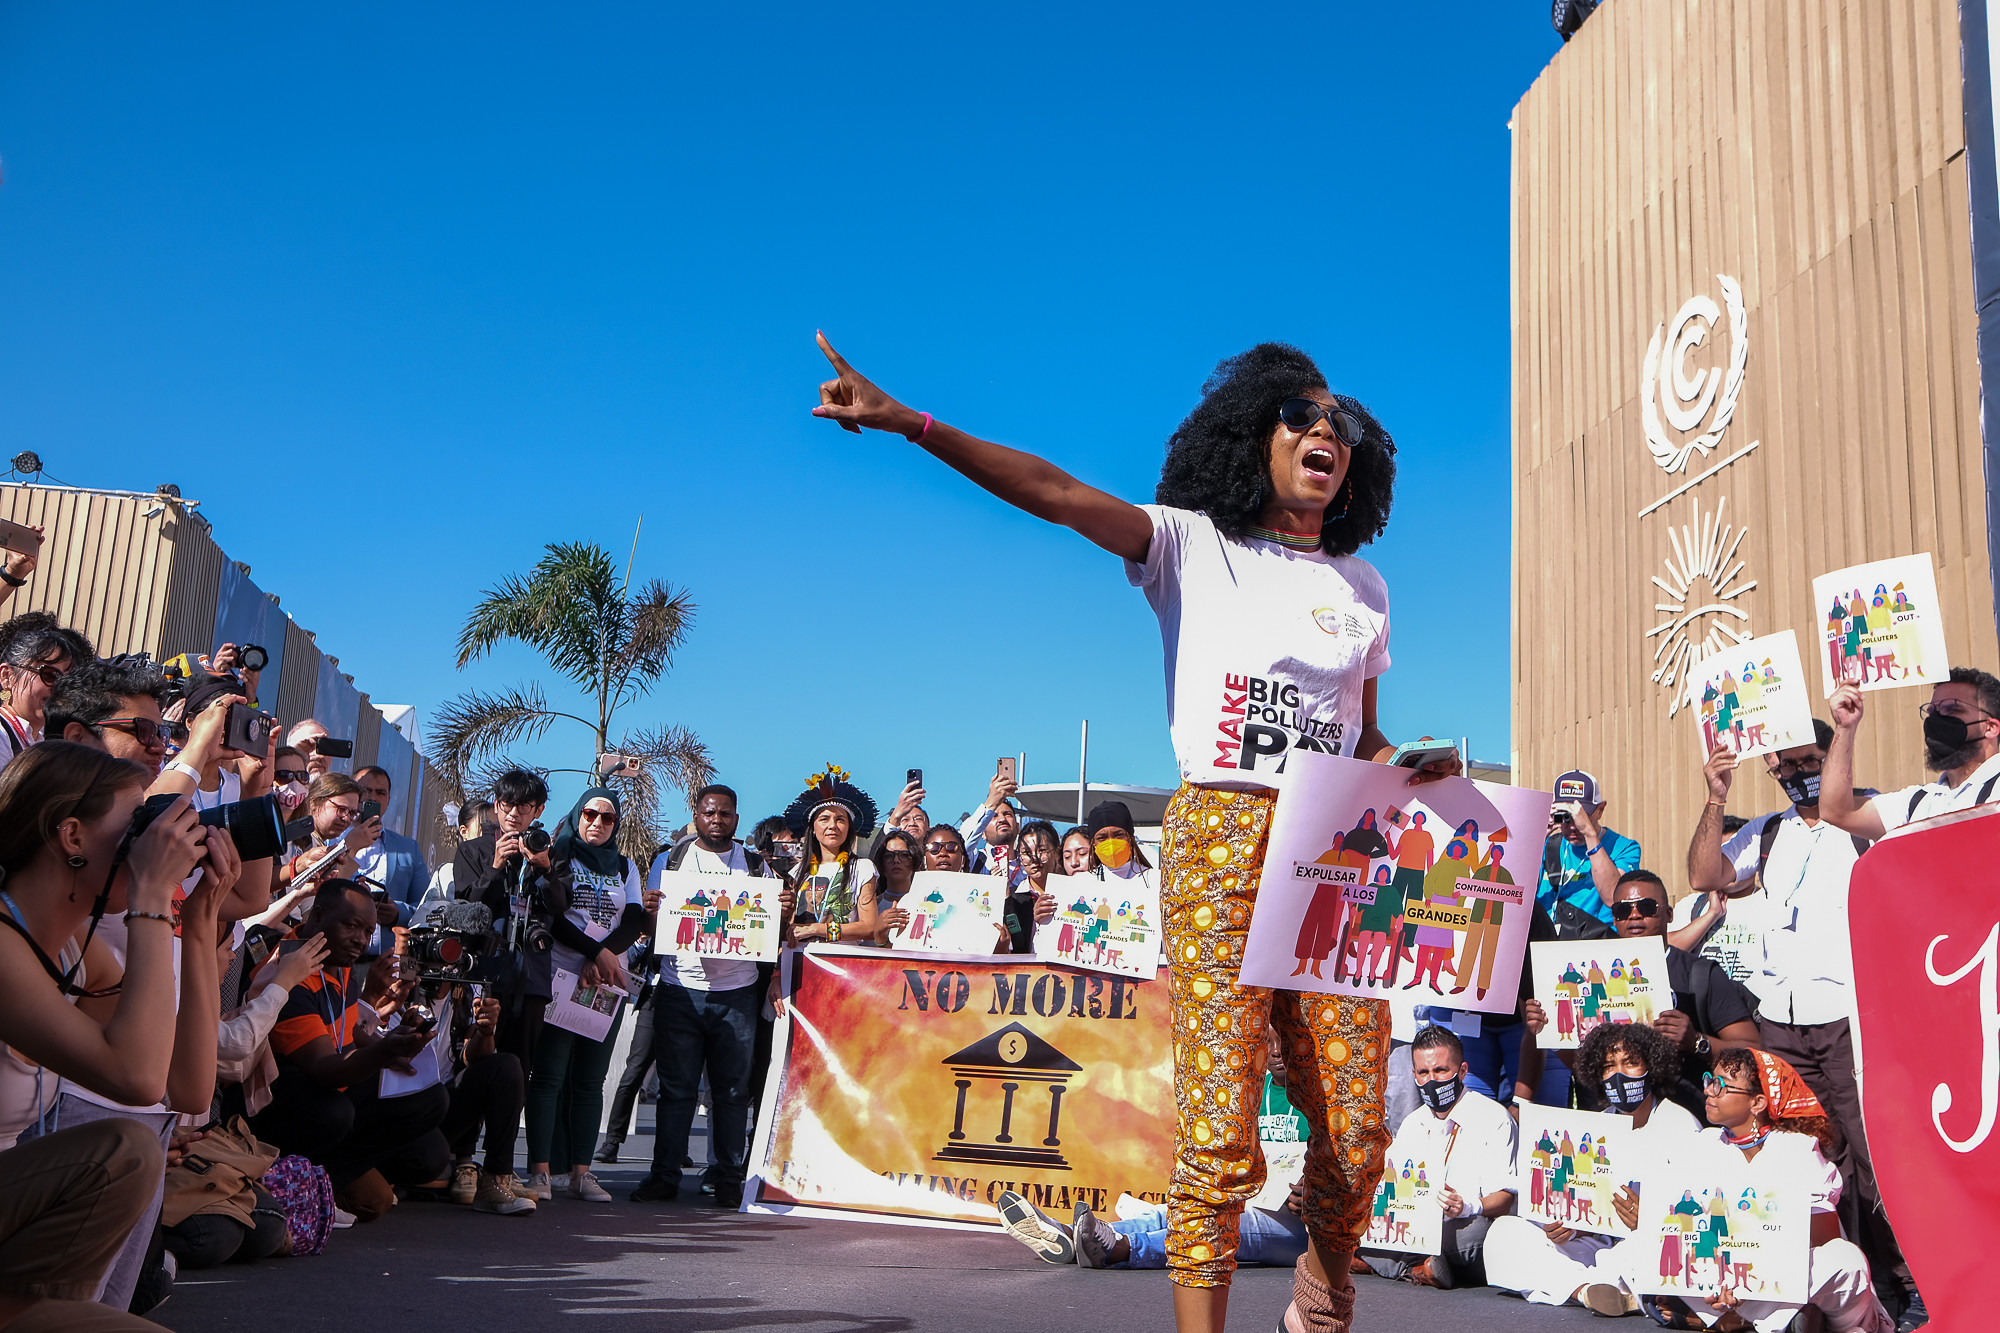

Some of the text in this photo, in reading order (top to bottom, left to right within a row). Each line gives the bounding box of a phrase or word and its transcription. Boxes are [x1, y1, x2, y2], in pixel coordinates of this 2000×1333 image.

[1897, 614, 1915, 622] OUT
[1861, 633, 1898, 644] POLLUTERS
[1249, 677, 1300, 709] BIG
[1765, 685, 1782, 694] OUT
[1733, 704, 1768, 718] POLLUTERS
[1213, 672, 1248, 769] MAKE
[1246, 703, 1344, 740] POLLUTERS
[1296, 866, 1356, 884] EXPULSAR
[1342, 887, 1375, 901] A LOS
[1455, 882, 1523, 898] CONTAMINADORES
[1407, 907, 1468, 926] GRANDES
[727, 923, 746, 931] GROS
[1101, 935, 1128, 943] GRANDES
[897, 969, 1139, 1020] NO MORE
[1600, 1001, 1635, 1009] POLLUTERS
[1435, 1081, 1455, 1095] WITHOUT
[1623, 1080, 1645, 1090] WITHOUT
[1438, 1089, 1455, 1101] HUMAN
[1625, 1087, 1644, 1097] HUMAN
[1439, 1094, 1456, 1107] RIGHTS
[1626, 1094, 1644, 1104] RIGHTS
[1544, 1169, 1554, 1177] BIG
[1596, 1166, 1609, 1174] OUT
[1567, 1178, 1597, 1188] POLLUTERS
[1416, 1189, 1429, 1197] OUT
[1762, 1224, 1782, 1232] OUT
[1684, 1233, 1698, 1241] BIG
[1720, 1241, 1760, 1249] POLLUTERS
